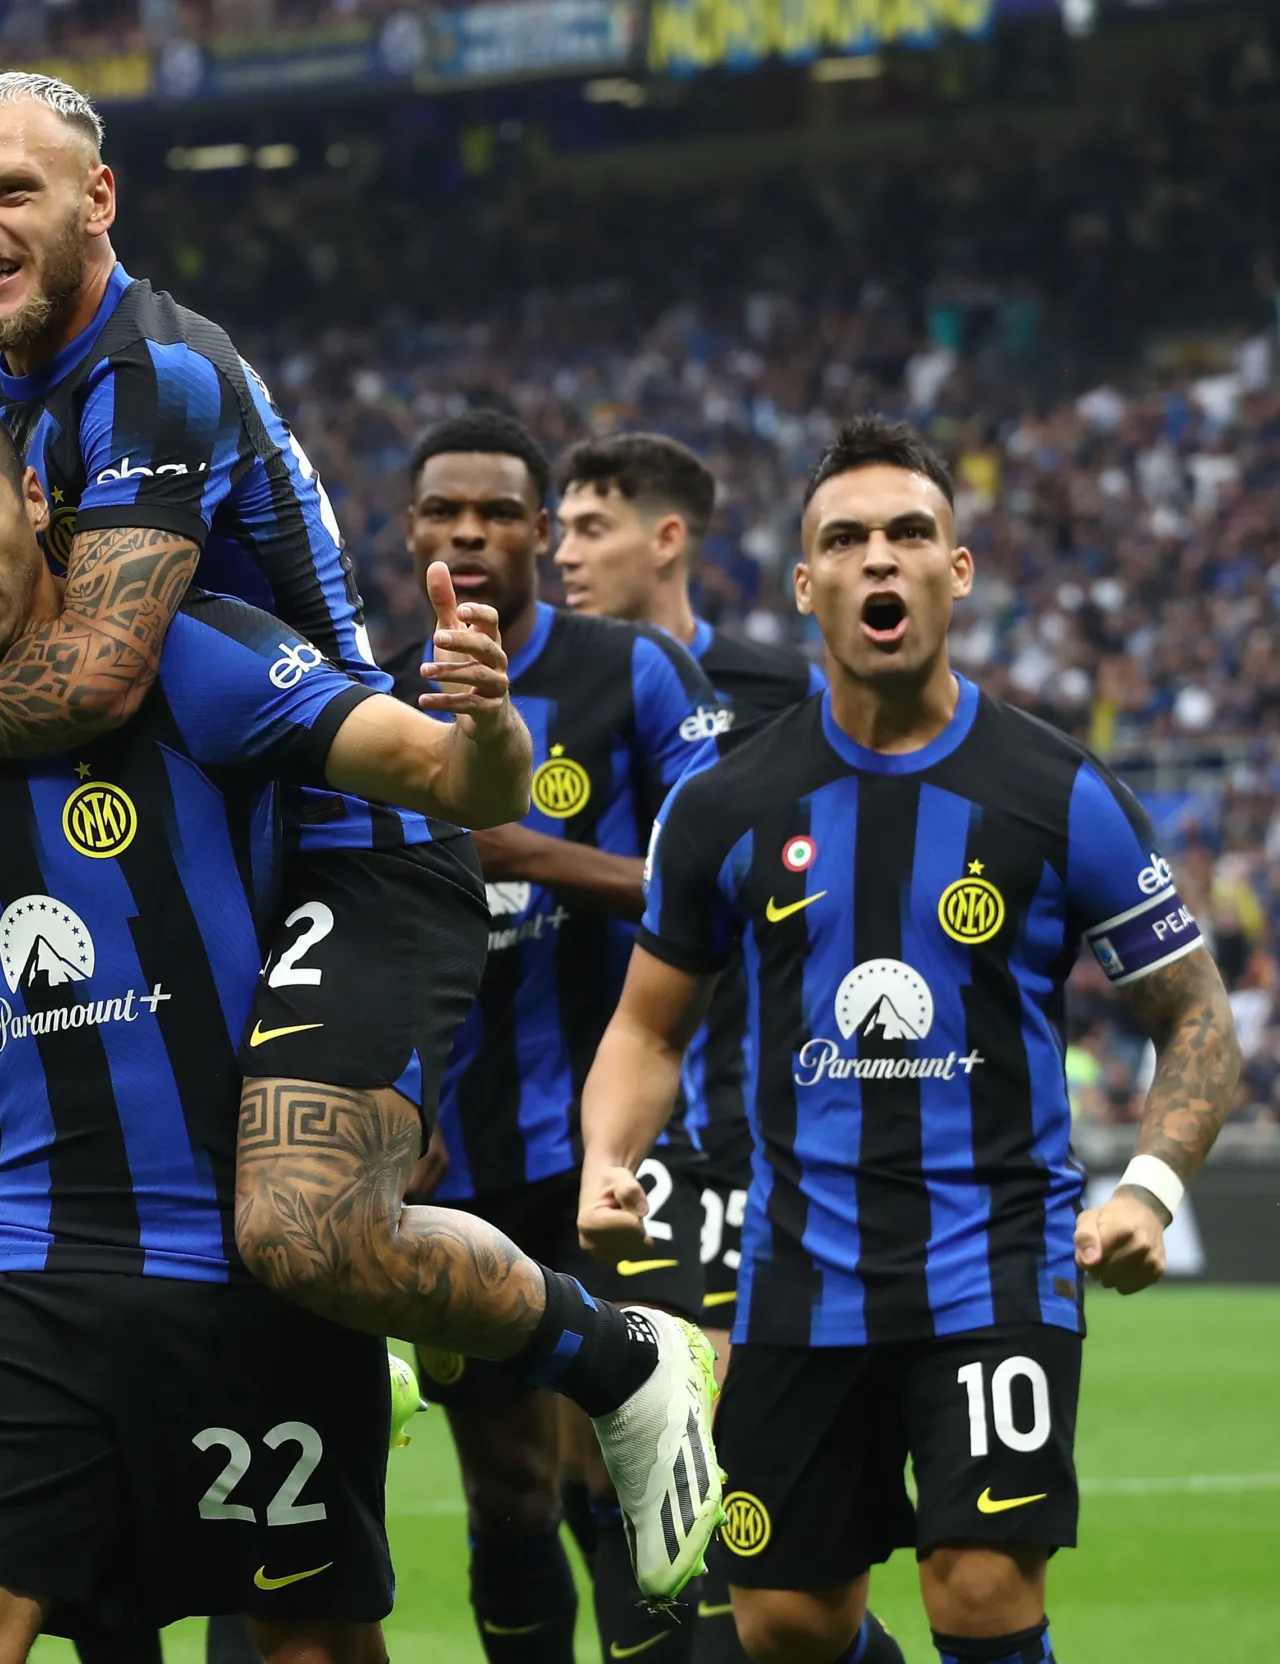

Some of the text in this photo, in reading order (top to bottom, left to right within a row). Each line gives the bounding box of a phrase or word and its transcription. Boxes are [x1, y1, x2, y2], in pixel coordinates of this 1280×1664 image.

[268, 642, 330, 690] eb
[258, 901, 335, 989] 2
[1151, 904, 1195, 941] PEA
[793, 1037, 985, 1087] Paramount+
[635, 1158, 673, 1241] 2
[956, 1355, 1053, 1458] 10
[191, 1420, 328, 1528] 22
